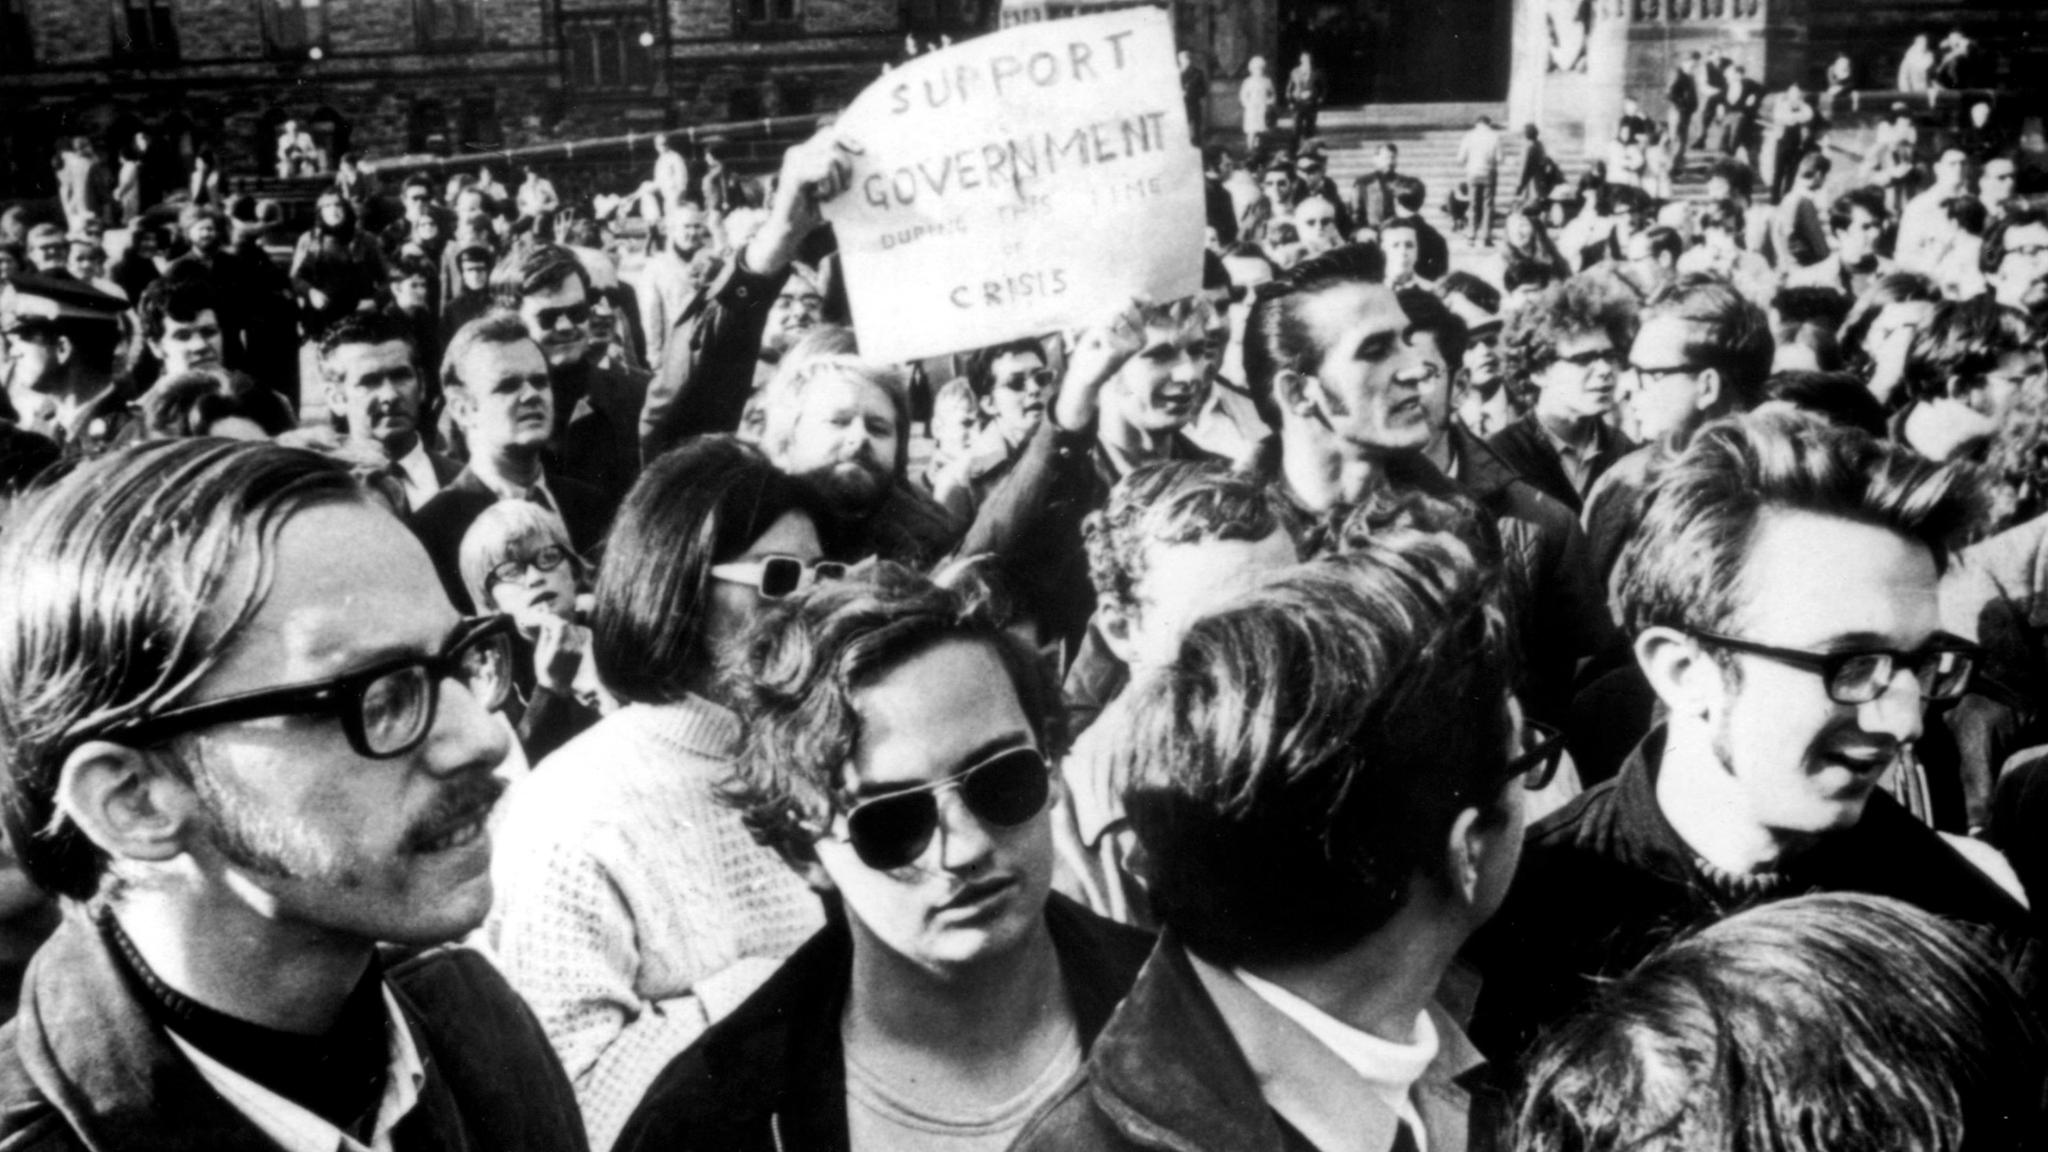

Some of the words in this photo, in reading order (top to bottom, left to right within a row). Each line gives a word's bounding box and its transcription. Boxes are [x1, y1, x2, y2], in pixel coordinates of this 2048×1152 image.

[890, 31, 1134, 116] SUPPORT
[863, 111, 1165, 210] GOVERNMENT
[949, 269, 1068, 309] CRISIS
